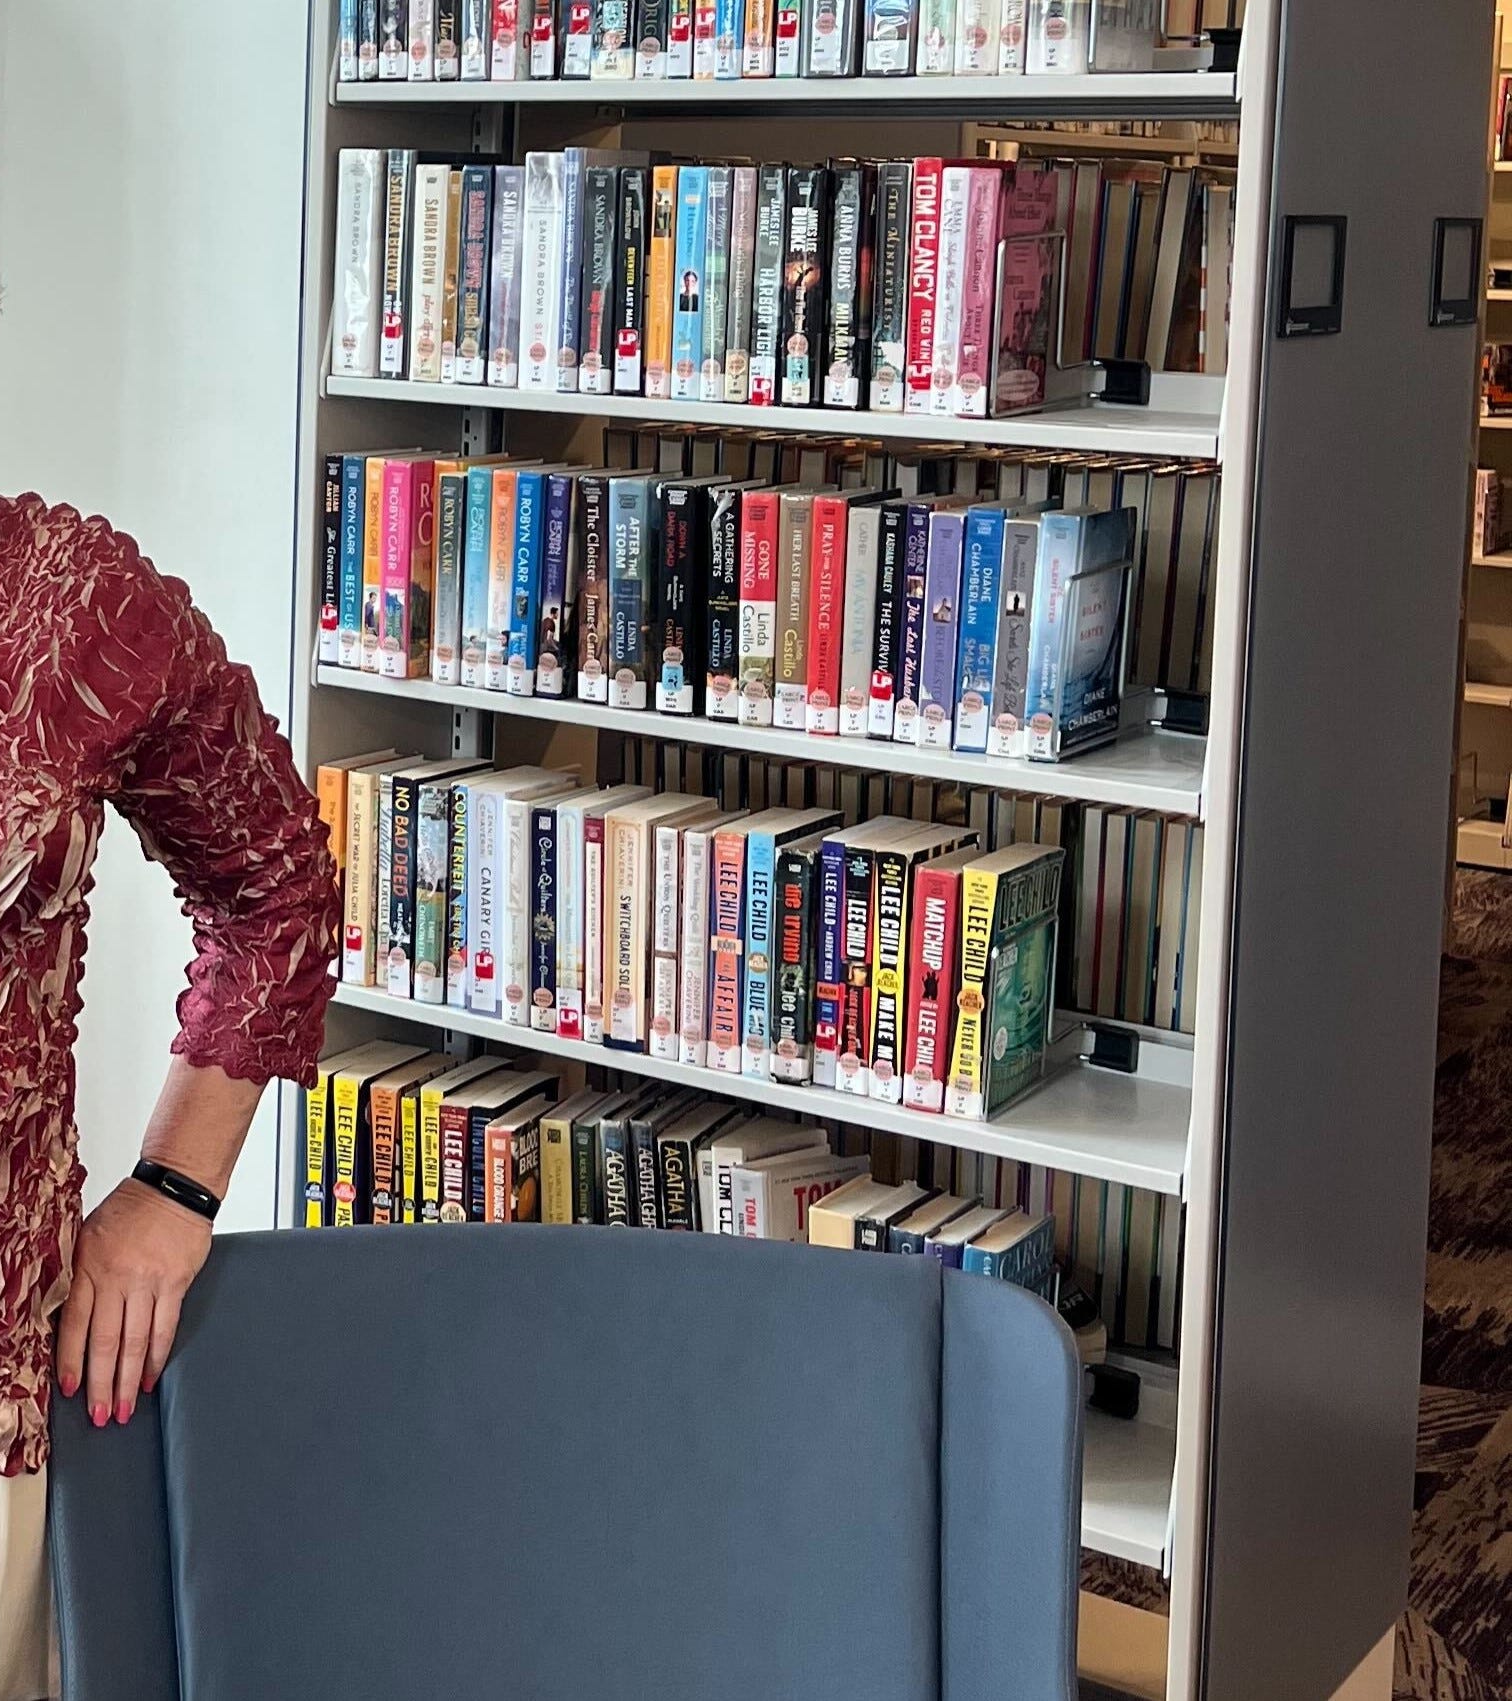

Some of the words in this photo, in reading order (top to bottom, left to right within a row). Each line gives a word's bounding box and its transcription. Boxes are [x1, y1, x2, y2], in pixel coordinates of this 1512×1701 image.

[534, 18, 552, 30] LP
[572, 8, 589, 21] LP
[672, 16, 690, 29] LP
[779, 11, 798, 25] LP
[915, 173, 937, 215] TOM
[425, 199, 438, 241] SANDRA
[502, 190, 517, 235] SANDRA
[594, 194, 604, 241] SANDRA
[790, 207, 806, 252] BURKE
[839, 205, 854, 242] ANNA
[537, 220, 547, 267] SANDRA
[913, 220, 936, 301] CLANCY
[422, 246, 436, 285] BROWN
[592, 244, 602, 284] BROWN
[837, 247, 851, 289] BURNS
[536, 272, 545, 315] BROWN
[758, 268, 775, 323] HARBOR
[348, 486, 357, 523] ROBYN
[371, 492, 379, 526] ROBYN
[389, 486, 399, 532] ROBYN
[443, 499, 455, 538] ROBYN
[520, 498, 532, 543] ROBYN
[586, 505, 600, 530] The
[725, 512, 733, 521] A
[347, 525, 355, 555] CARR
[498, 507, 508, 546] ROBYN
[629, 517, 640, 555] AFTER
[792, 530, 802, 551] HER
[822, 523, 834, 555] PRAY
[388, 535, 398, 570] CARR
[517, 547, 530, 582] CARR
[585, 531, 600, 583] Cloister
[615, 524, 627, 569] STORM
[713, 531, 722, 577] SECRETS
[724, 523, 734, 583] GATHERING
[743, 531, 755, 588] MISSING
[758, 540, 770, 580] GONE
[325, 546, 336, 590] Greatest
[496, 550, 506, 582] CARR
[629, 559, 638, 577] THE
[791, 553, 801, 579] LAST
[967, 543, 980, 625] CHAMBERLAIN
[345, 574, 355, 601] BEST
[790, 581, 801, 621] BREATH
[819, 573, 832, 630] SILENCE
[981, 568, 993, 602] DIANE
[742, 605, 755, 653] Castillo
[757, 613, 770, 646] Linda
[880, 602, 892, 626] THE
[615, 612, 625, 659] CASTILLO
[627, 621, 636, 651] LINDA
[711, 619, 721, 667] CASTILLO
[723, 629, 732, 659] LINDA
[783, 629, 797, 678] Castillo
[978, 644, 990, 664] BIG
[395, 786, 410, 811] NO
[394, 815, 409, 848] BAD
[452, 791, 466, 893] COUNTERFEIT
[351, 873, 360, 893] JULIA
[393, 853, 409, 897] DEED
[719, 862, 738, 886] LEE
[752, 871, 768, 895] LEE
[825, 872, 837, 892] LEE
[351, 896, 359, 921] CHILD
[480, 867, 492, 926] CANARY
[719, 891, 738, 932] CHILD
[823, 895, 837, 925] CHILD
[848, 899, 866, 922] LEE
[881, 886, 901, 915] LEE
[619, 895, 631, 966] SWITCHBOARD
[751, 899, 767, 941] CHILD
[922, 896, 945, 971] MATCHUP
[968, 905, 988, 936] LEE
[846, 922, 866, 958] CHILD
[880, 918, 900, 964] CHILD
[964, 938, 987, 983] CHILD
[716, 974, 735, 1032] AFFAIR
[749, 981, 765, 1011] BLUE
[781, 991, 797, 1011] lee
[560, 1010, 579, 1023] LP
[877, 997, 894, 1039] MAKE
[918, 1009, 936, 1035] LEE
[960, 1018, 975, 1051] NEVER
[310, 1100, 323, 1117] LEE
[338, 1106, 352, 1131] LEE
[425, 1116, 437, 1133] LEE
[376, 1115, 391, 1139] LEE
[404, 1125, 414, 1142] LEE
[444, 1130, 461, 1155] LEE
[309, 1140, 323, 1170] CHILD
[337, 1135, 353, 1176] CHILD
[375, 1144, 391, 1183] CHILD
[404, 1146, 414, 1177] CHILD
[425, 1157, 437, 1188] CHILD
[494, 1158, 505, 1184] BLOOD
[444, 1158, 462, 1200] CHILD
[606, 1149, 625, 1217] AGATHA
[639, 1148, 654, 1200] AGATHA
[664, 1146, 685, 1214] AGATHA
[719, 1164, 732, 1200] TOM
[494, 1186, 504, 1217] ORANGE
[745, 1197, 756, 1227] TOM
